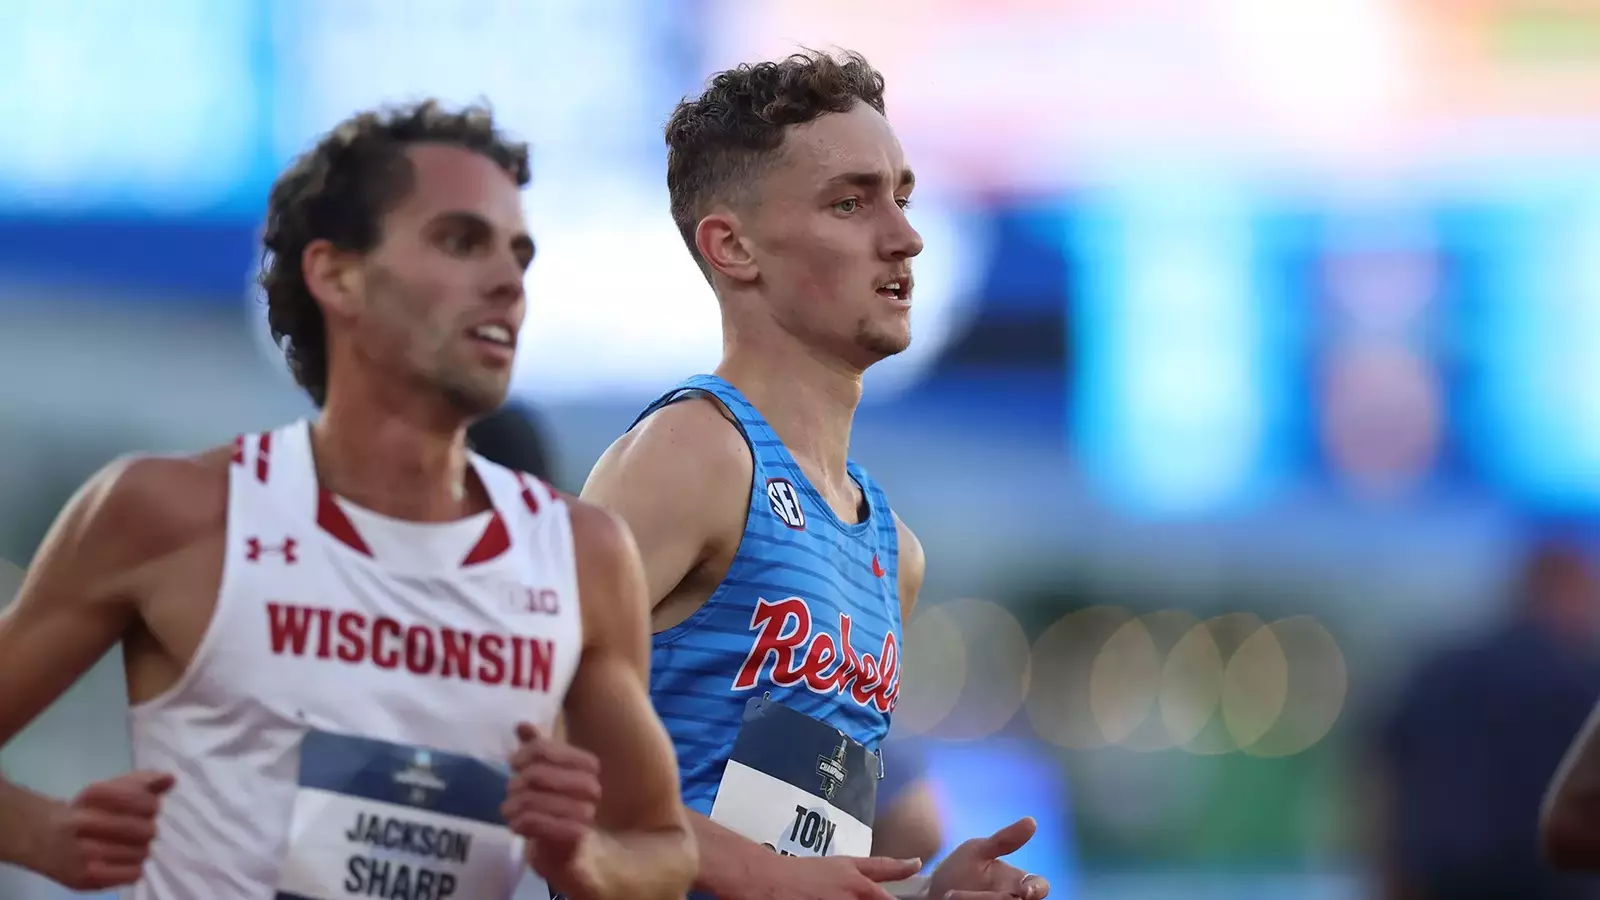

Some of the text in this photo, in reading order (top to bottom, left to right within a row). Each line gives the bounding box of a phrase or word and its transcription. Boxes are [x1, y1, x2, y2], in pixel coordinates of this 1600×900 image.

[266, 602, 555, 693] WISCONSIN
[345, 811, 473, 865] JACKSON
[789, 804, 837, 857] TOBY
[344, 855, 458, 900] SHARP
